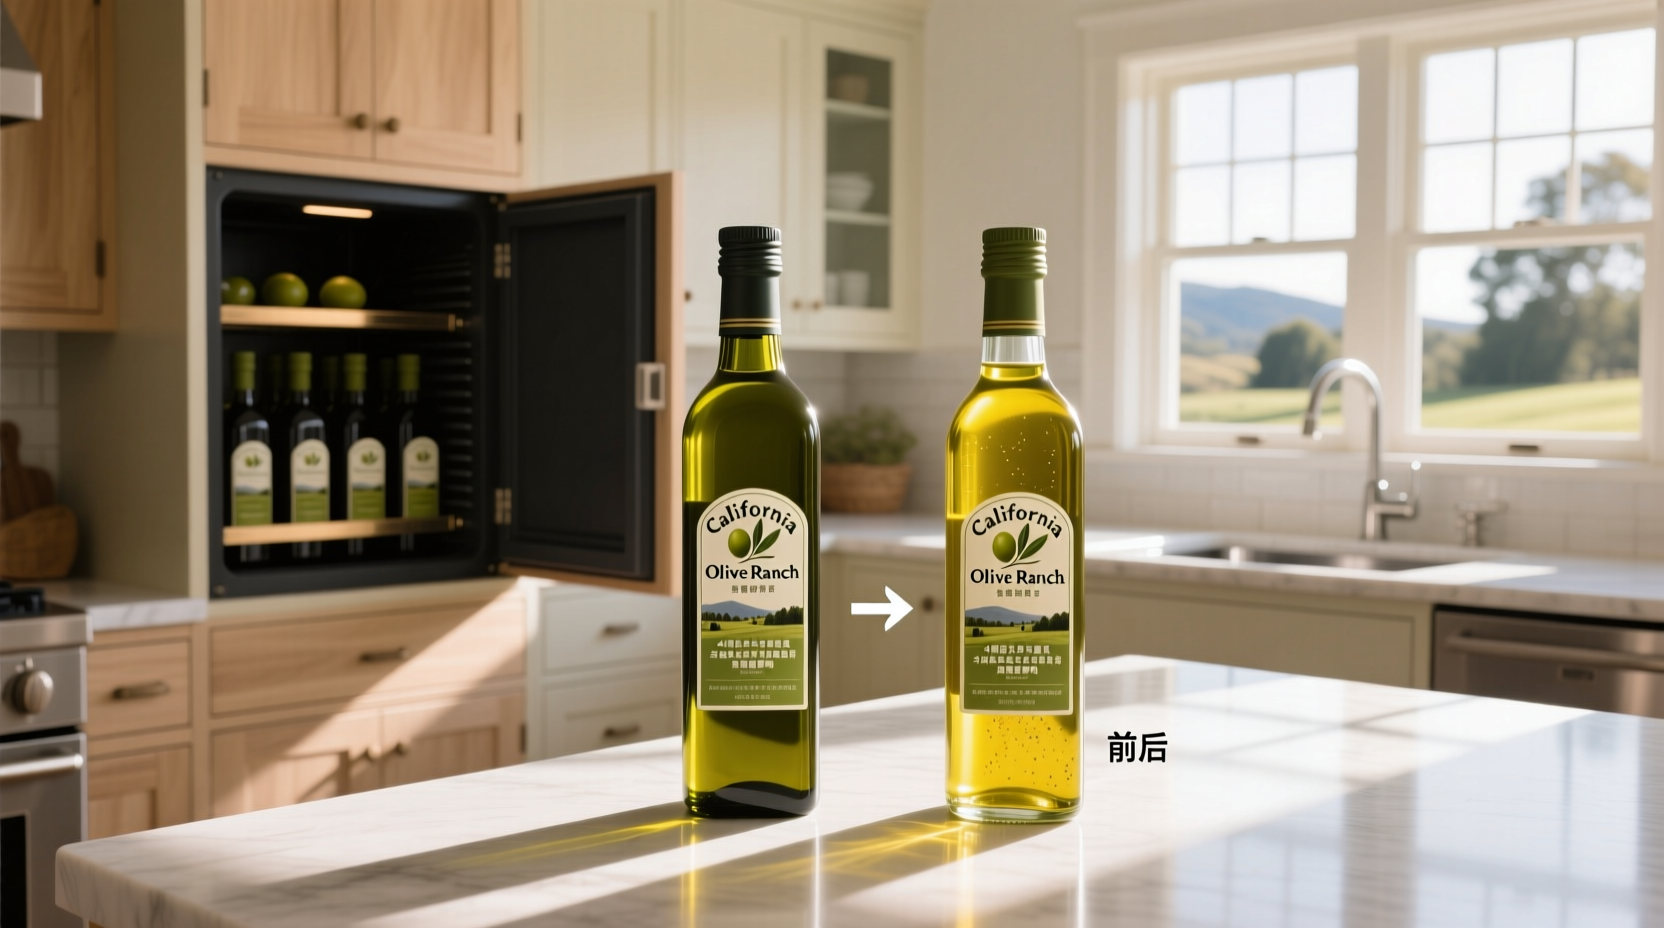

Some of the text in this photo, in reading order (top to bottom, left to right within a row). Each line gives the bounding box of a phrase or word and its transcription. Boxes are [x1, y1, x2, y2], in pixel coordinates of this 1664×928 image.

[706, 500, 797, 535] California
[972, 503, 1062, 539] California
[705, 564, 799, 580] Olive Ranch
[970, 568, 1065, 585] Olive Ranch
